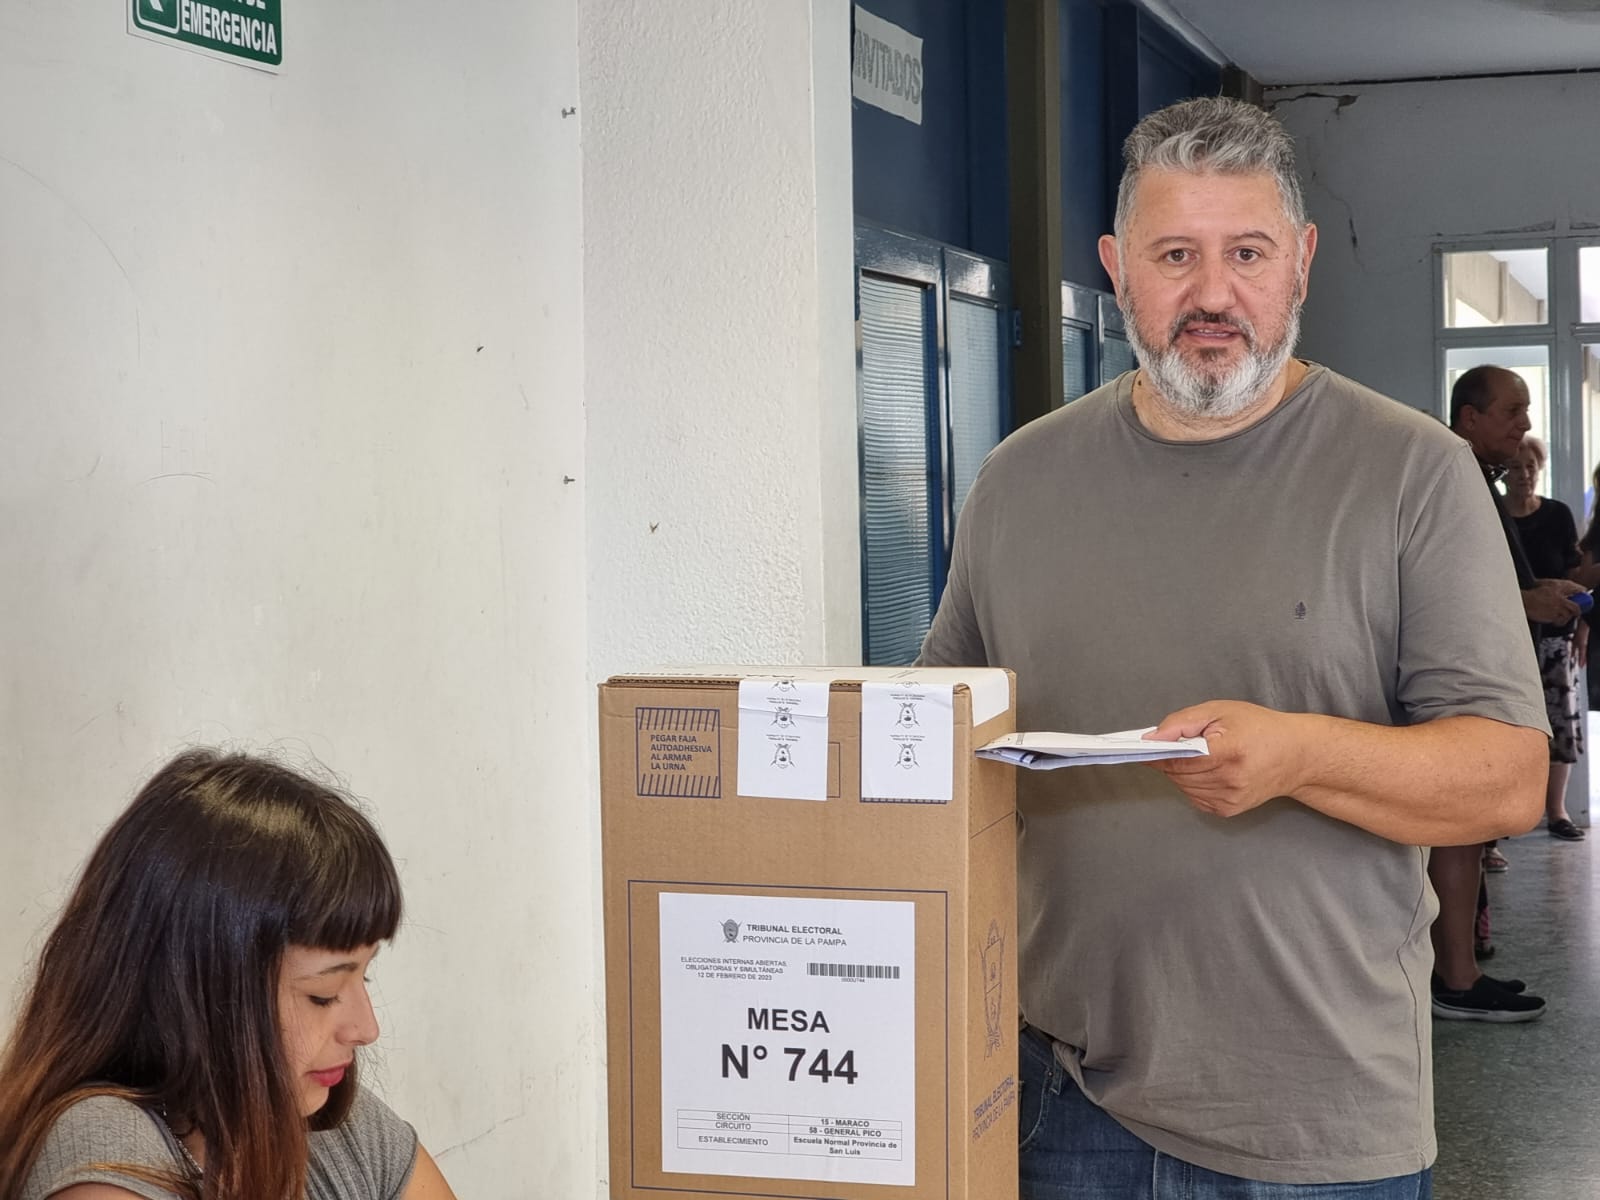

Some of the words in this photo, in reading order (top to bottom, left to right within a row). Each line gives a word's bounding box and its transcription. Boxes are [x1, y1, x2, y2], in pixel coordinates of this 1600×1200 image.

[181, 0, 278, 55] EMERGENCIA
[650, 734, 677, 742] PEGAR
[679, 735, 697, 743] FAJA
[650, 744, 712, 753] AUTOADHESIVA
[651, 753, 660, 761] AL
[663, 754, 693, 762] ARMAR
[663, 763, 686, 771] URNA
[747, 924, 790, 933] TRIBUNAL
[792, 925, 842, 935] ELECTORAL
[743, 935, 789, 944] PROVINCIA
[791, 937, 803, 945] DE
[817, 937, 847, 946] PAMPA
[681, 956, 721, 964] ELECCIONES
[755, 959, 787, 967] ABIERTAS
[685, 964, 732, 972] OBLIGATORIAS
[748, 1007, 830, 1033] MESA
[783, 1047, 858, 1085] 744
[715, 1122, 751, 1130] CIRCUITO
[821, 1118, 829, 1126] 15
[824, 1127, 860, 1137] GENERAL
[862, 1129, 882, 1138] PICO
[698, 1135, 769, 1146] ESTABLECIMIENTO
[793, 1136, 822, 1145] Escuela
[824, 1138, 850, 1146] Normal
[851, 1140, 887, 1148] Provincia
[888, 1141, 898, 1149] de
[829, 1147, 843, 1155] San
[845, 1148, 861, 1156] Luis
